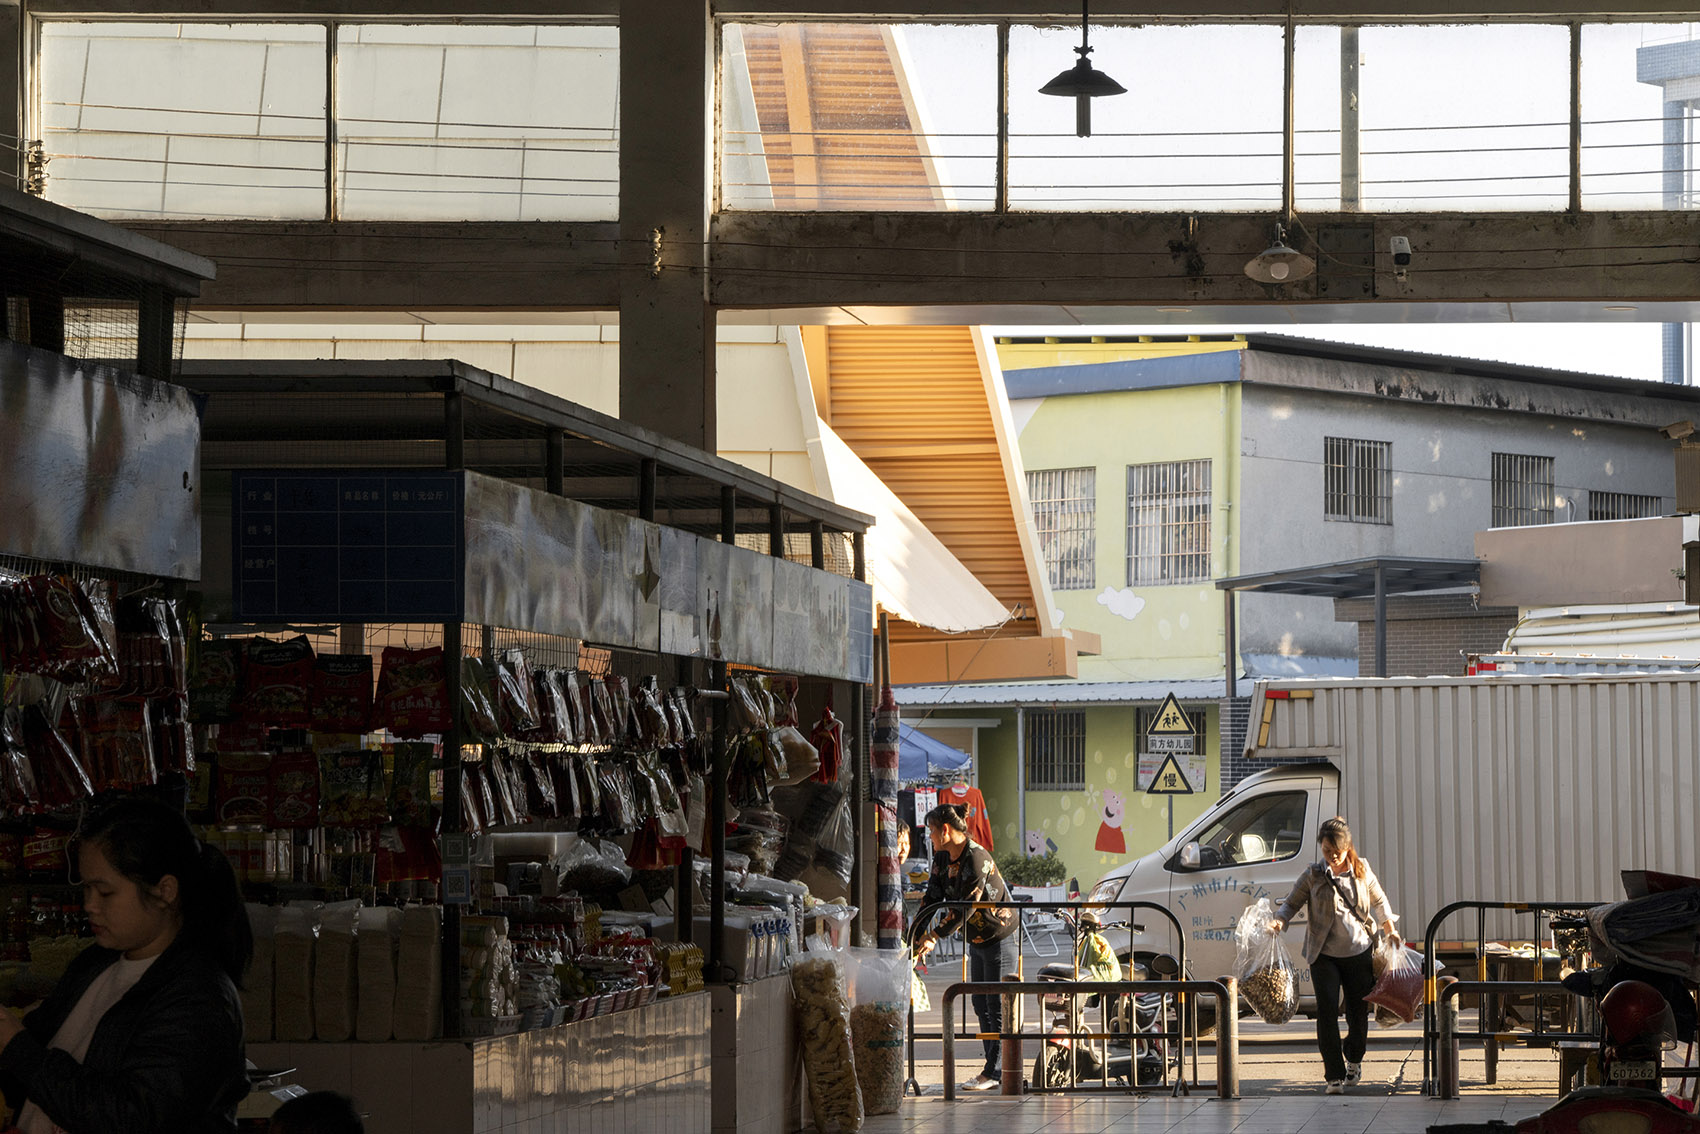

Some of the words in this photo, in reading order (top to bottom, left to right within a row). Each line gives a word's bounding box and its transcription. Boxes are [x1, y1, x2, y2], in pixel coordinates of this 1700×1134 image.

[1149, 738, 1192, 749] 前方幼儿园
[1163, 773, 1177, 788] 慢
[1178, 876, 1271, 911] 广州市白云区
[1613, 1069, 1653, 1079] 607362
